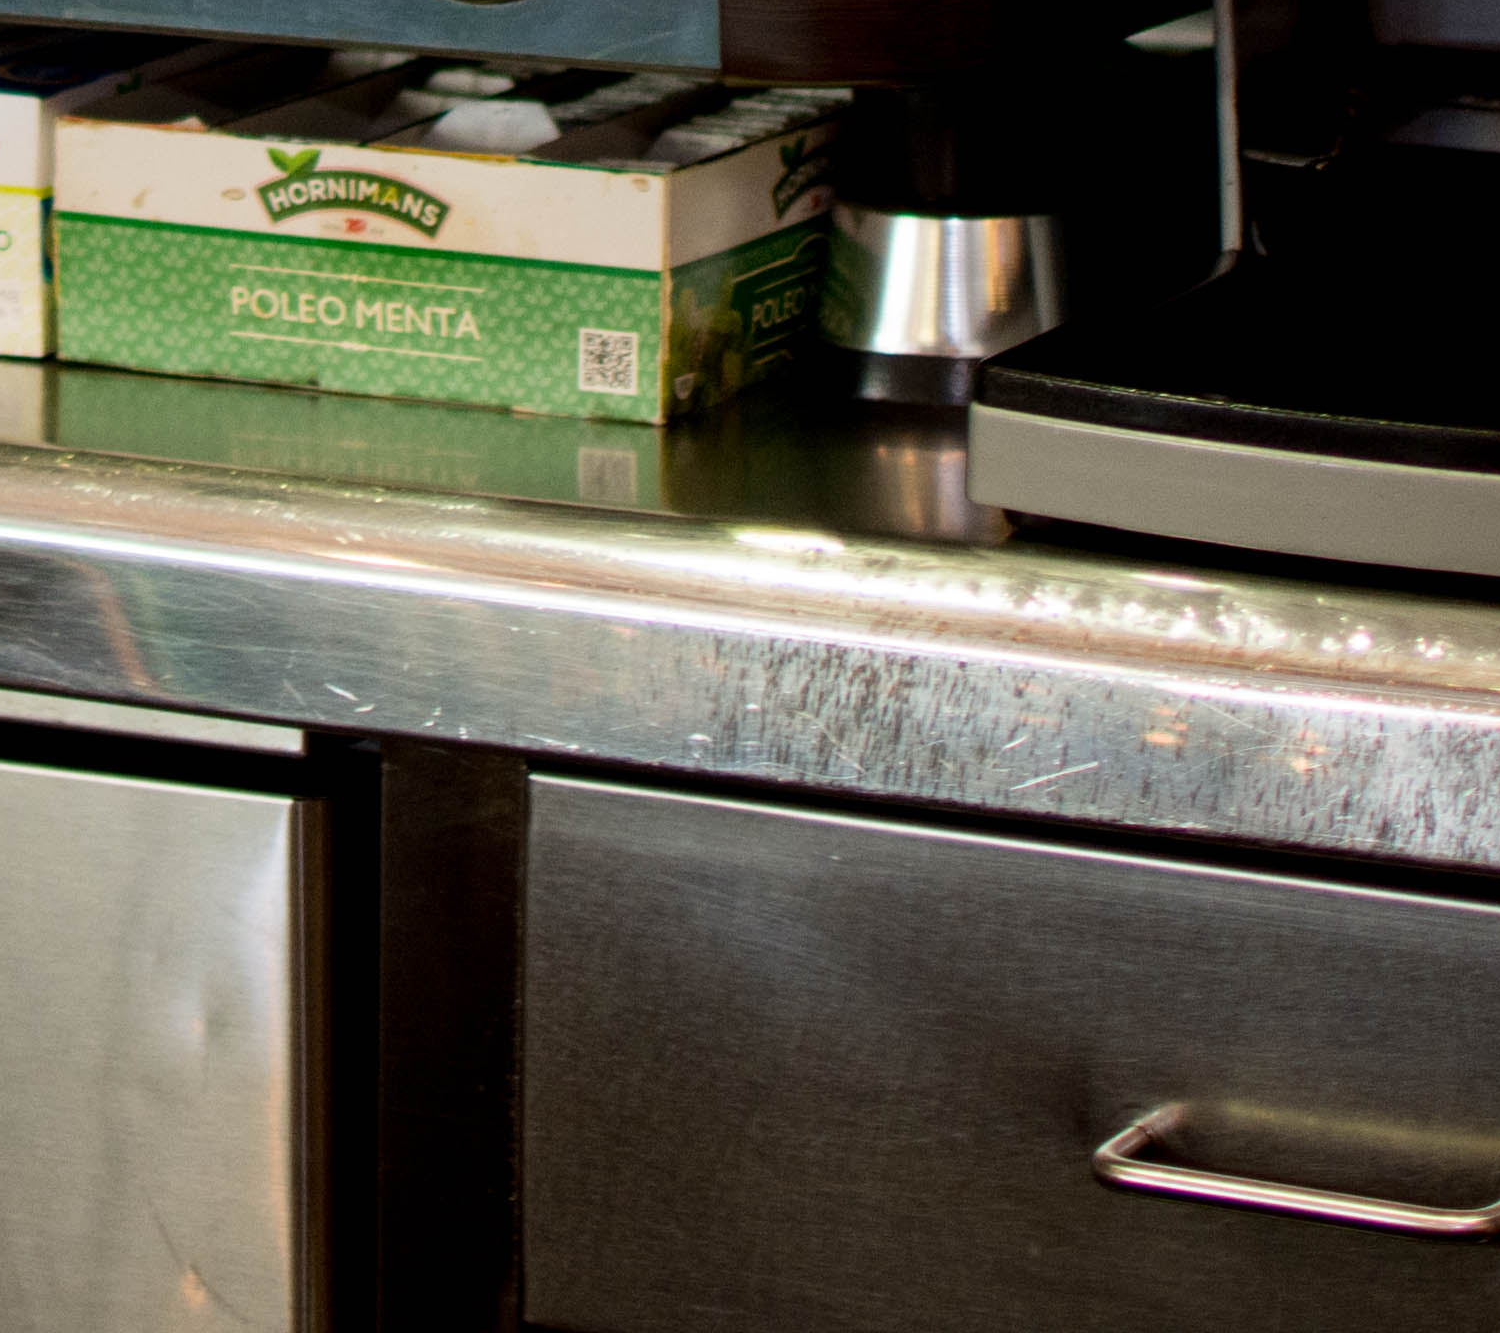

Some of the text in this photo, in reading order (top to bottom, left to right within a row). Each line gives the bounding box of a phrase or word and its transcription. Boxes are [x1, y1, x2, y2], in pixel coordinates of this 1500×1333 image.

[267, 177, 442, 228] HORNIMANS
[230, 285, 482, 341] POLEO MENTA
